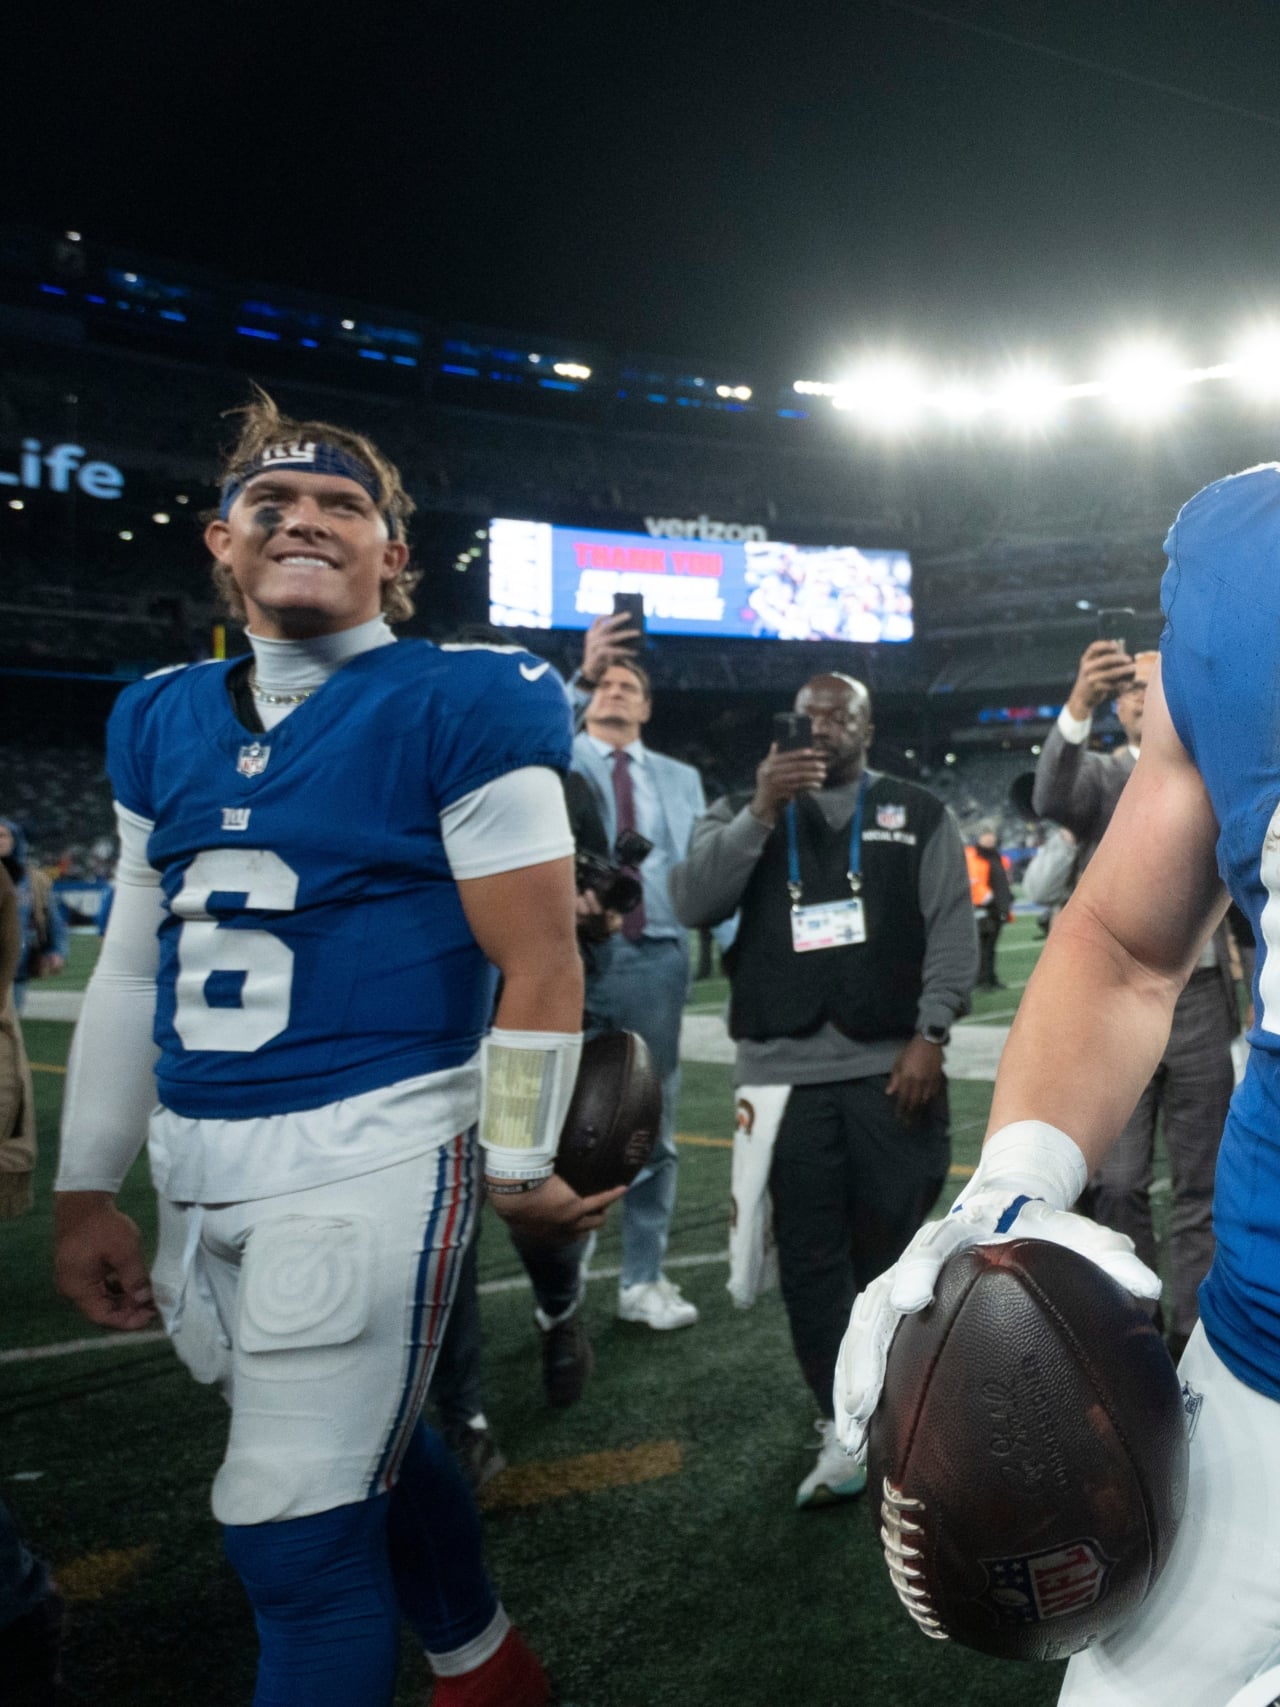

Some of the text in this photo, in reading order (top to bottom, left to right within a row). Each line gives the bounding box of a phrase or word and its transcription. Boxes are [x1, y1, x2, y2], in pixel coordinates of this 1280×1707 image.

[645, 515, 767, 543] verizon
[574, 543, 722, 577] THANK YOU
[170, 848, 298, 1053] 6
[1034, 1546, 1099, 1618] NFL
